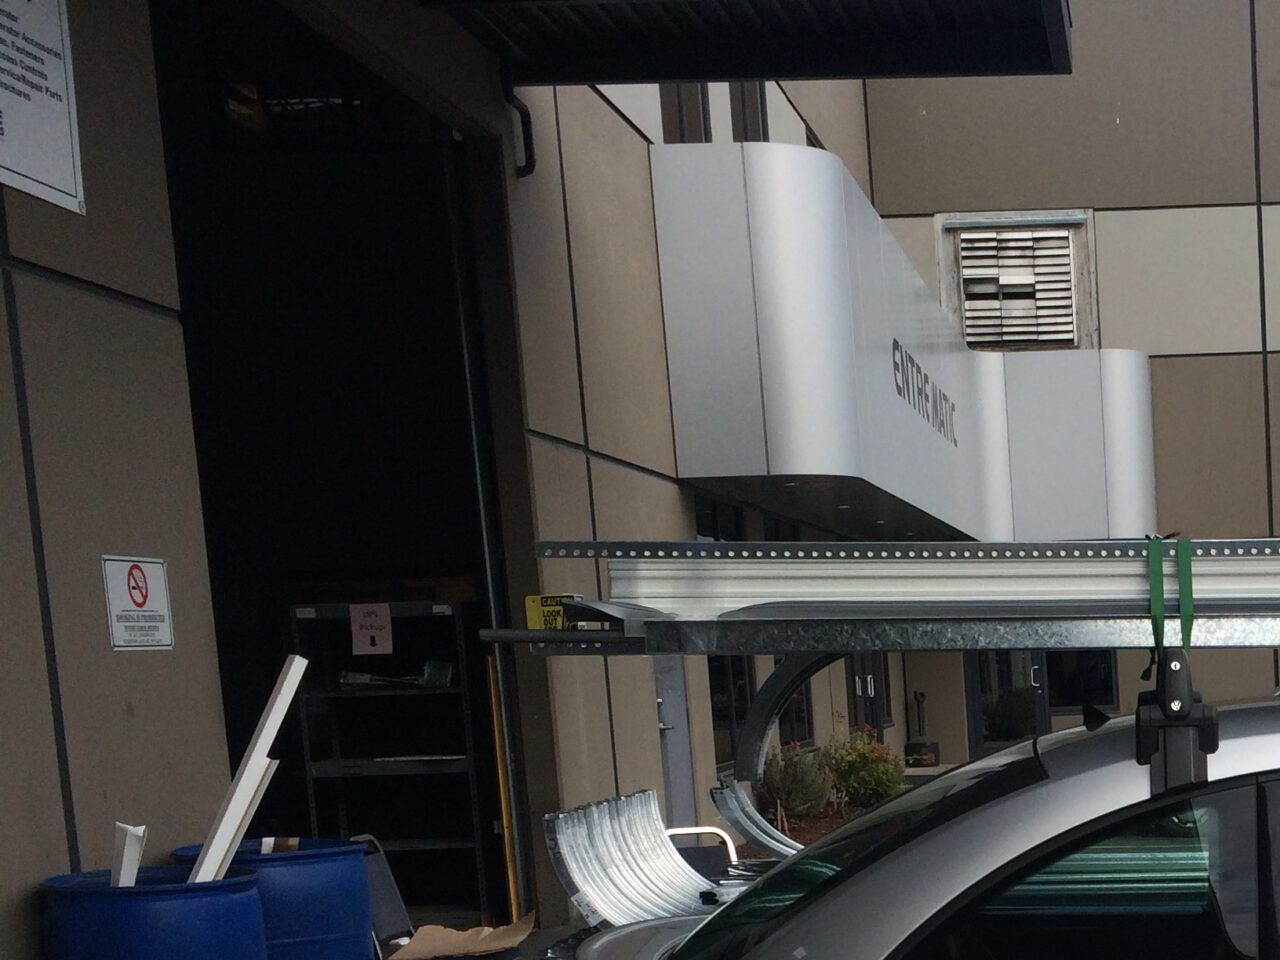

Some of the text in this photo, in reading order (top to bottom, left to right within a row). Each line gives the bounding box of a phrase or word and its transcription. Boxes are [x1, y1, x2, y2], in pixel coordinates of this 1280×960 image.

[892, 337, 958, 448] ENTRE MATIC
[543, 609, 562, 618] LOOK
